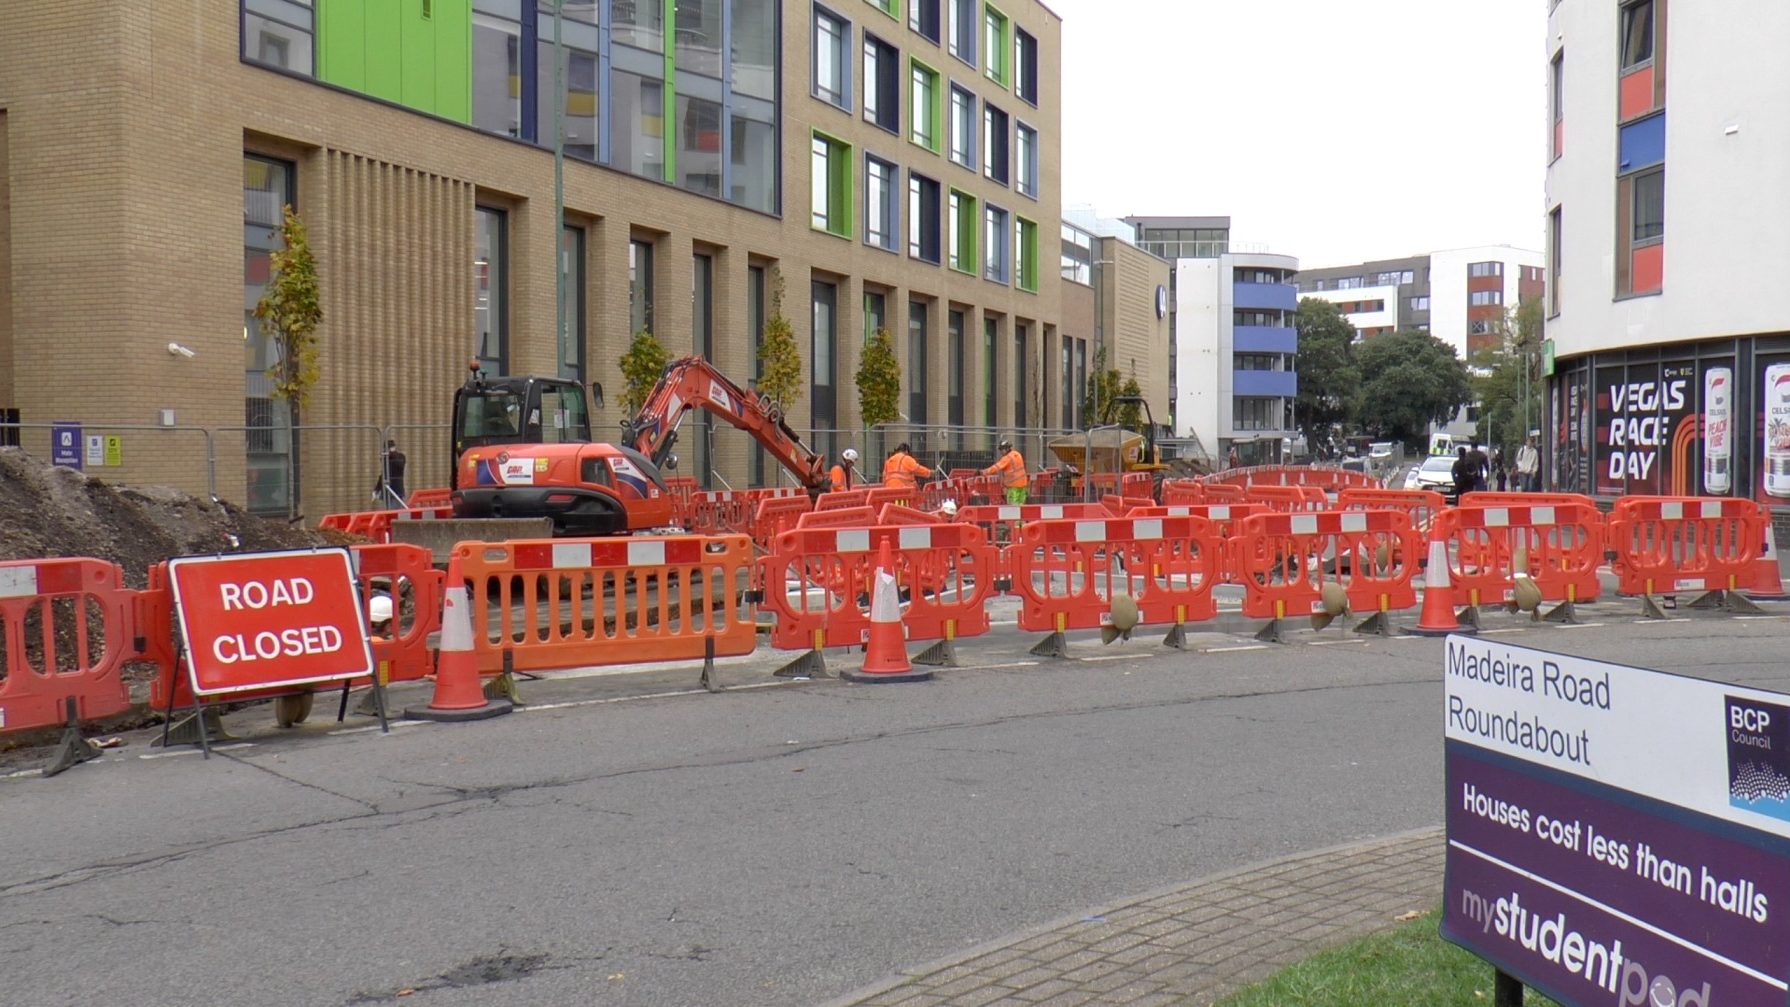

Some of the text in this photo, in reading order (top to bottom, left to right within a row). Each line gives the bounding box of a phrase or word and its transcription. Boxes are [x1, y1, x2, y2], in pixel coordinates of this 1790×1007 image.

[1610, 380, 1686, 413] VEGAS
[1771, 407, 1790, 415] CELS
[1608, 416, 1670, 446] RACE
[1608, 451, 1656, 480] DAY
[220, 577, 314, 611] ROAD
[213, 625, 343, 664] CLOSED
[1449, 642, 1611, 710] Madeira Road
[1449, 695, 1591, 766] Roundabout
[1731, 705, 1770, 733] BCP
[1732, 729, 1771, 750] Council
[1463, 782, 1768, 923] Houses cost less than halls
